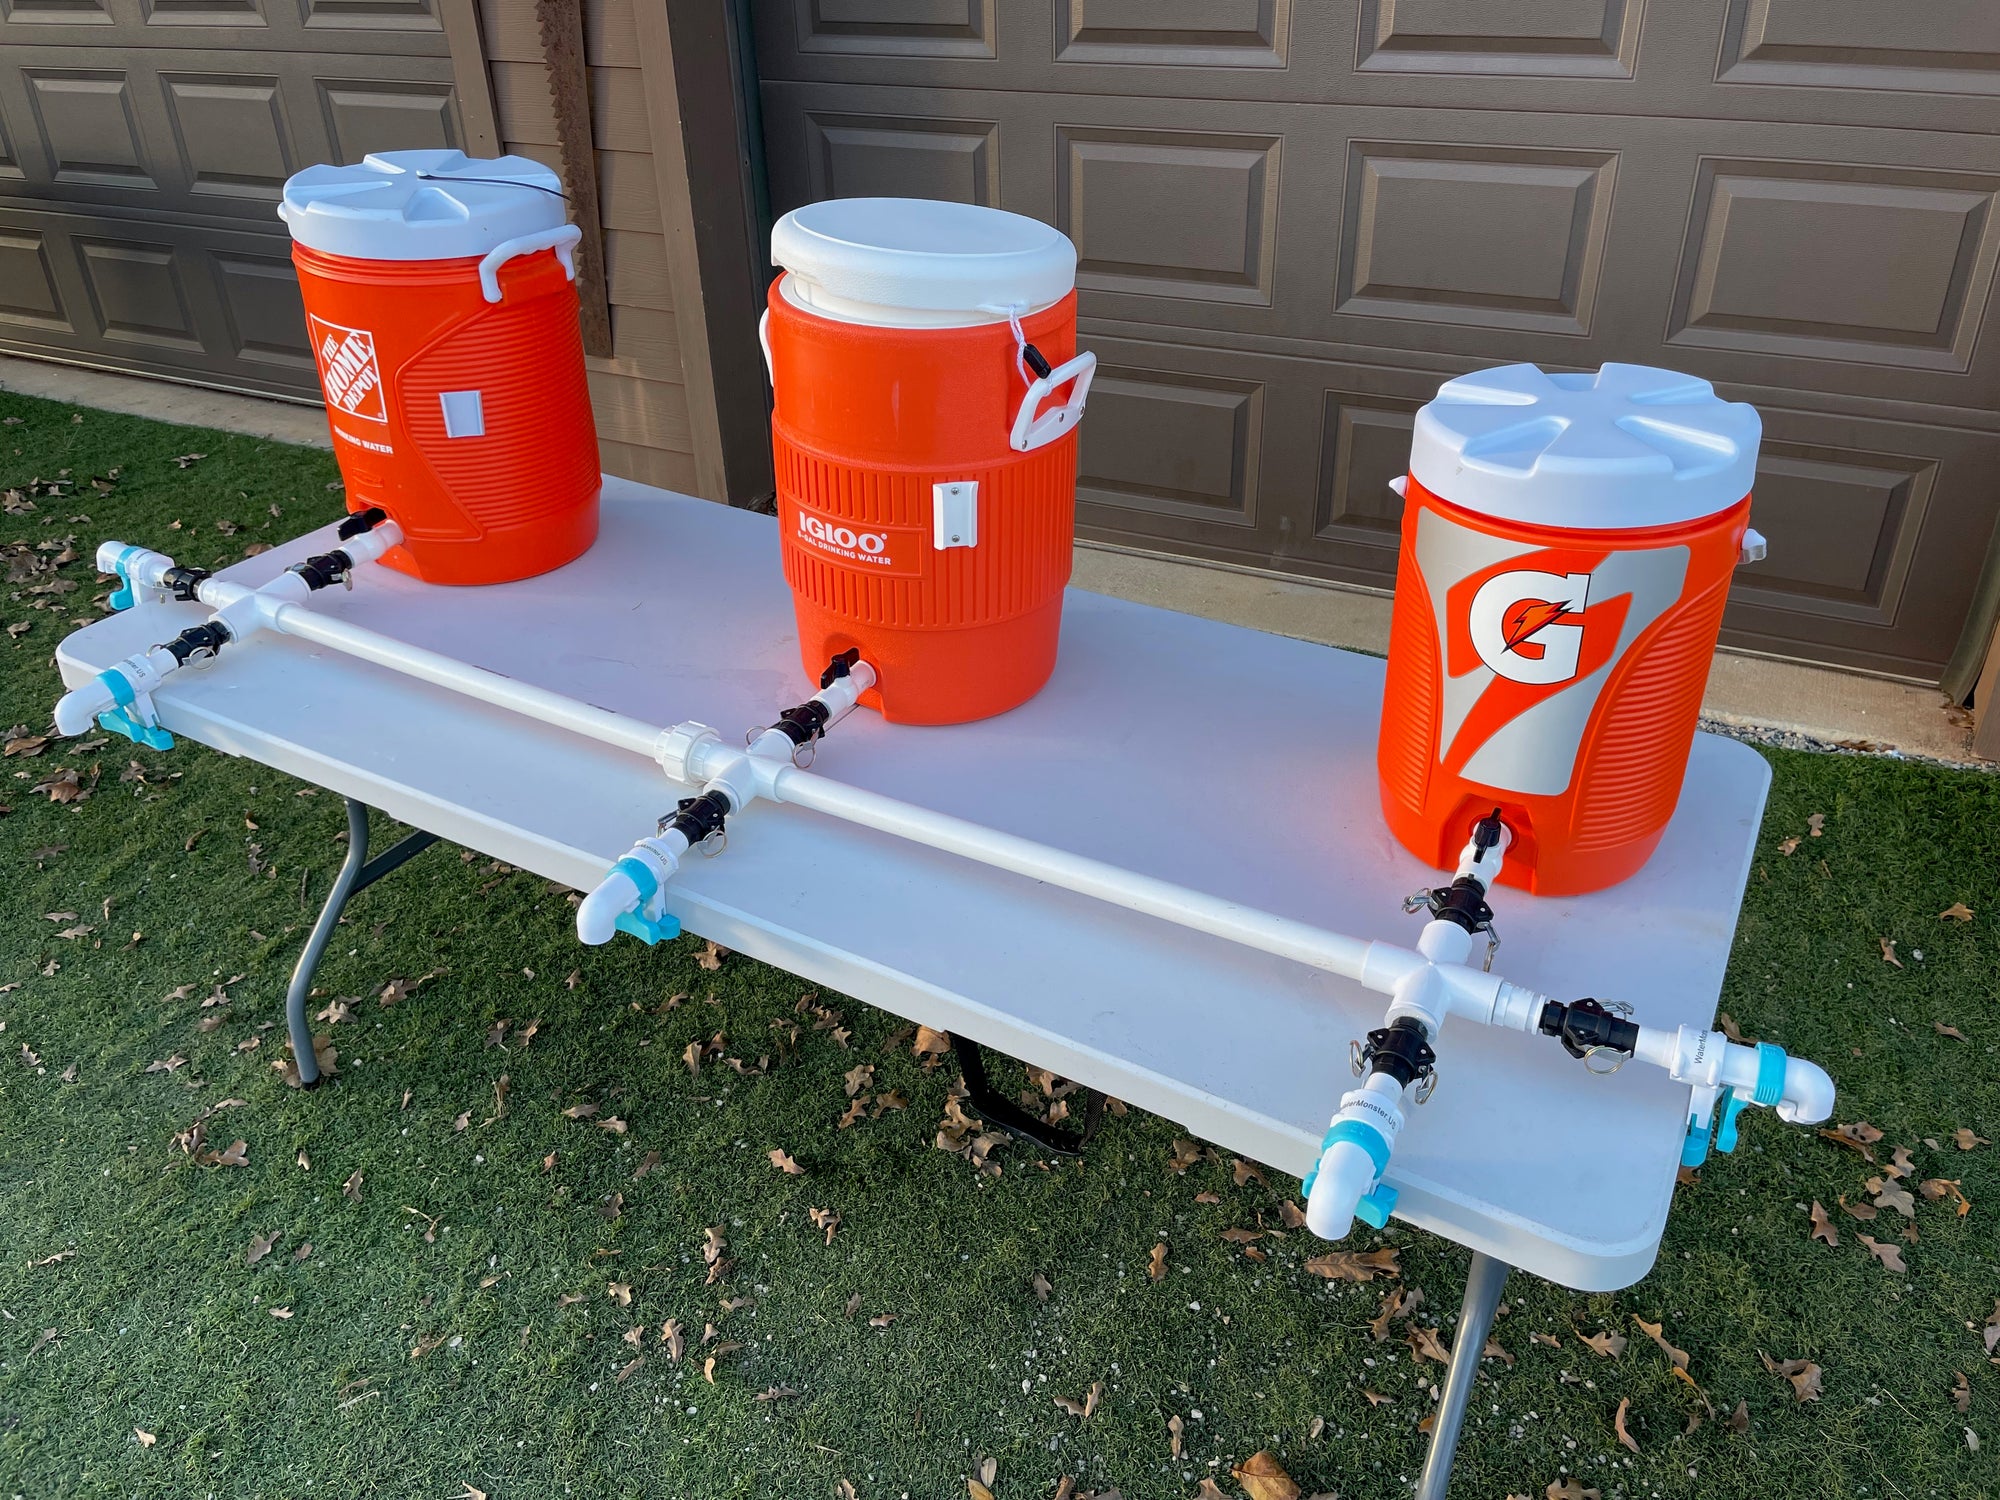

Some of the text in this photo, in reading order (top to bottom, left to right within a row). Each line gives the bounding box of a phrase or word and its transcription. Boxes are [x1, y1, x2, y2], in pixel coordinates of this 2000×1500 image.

[322, 334, 339, 364] THE
[325, 331, 374, 406] HOME
[342, 365, 378, 412] DEPOT
[362, 438, 393, 455] WATER
[799, 510, 884, 554] IGLOO
[817, 540, 856, 559] DRINKING
[857, 552, 892, 566] WATER
[1469, 569, 1592, 686] G
